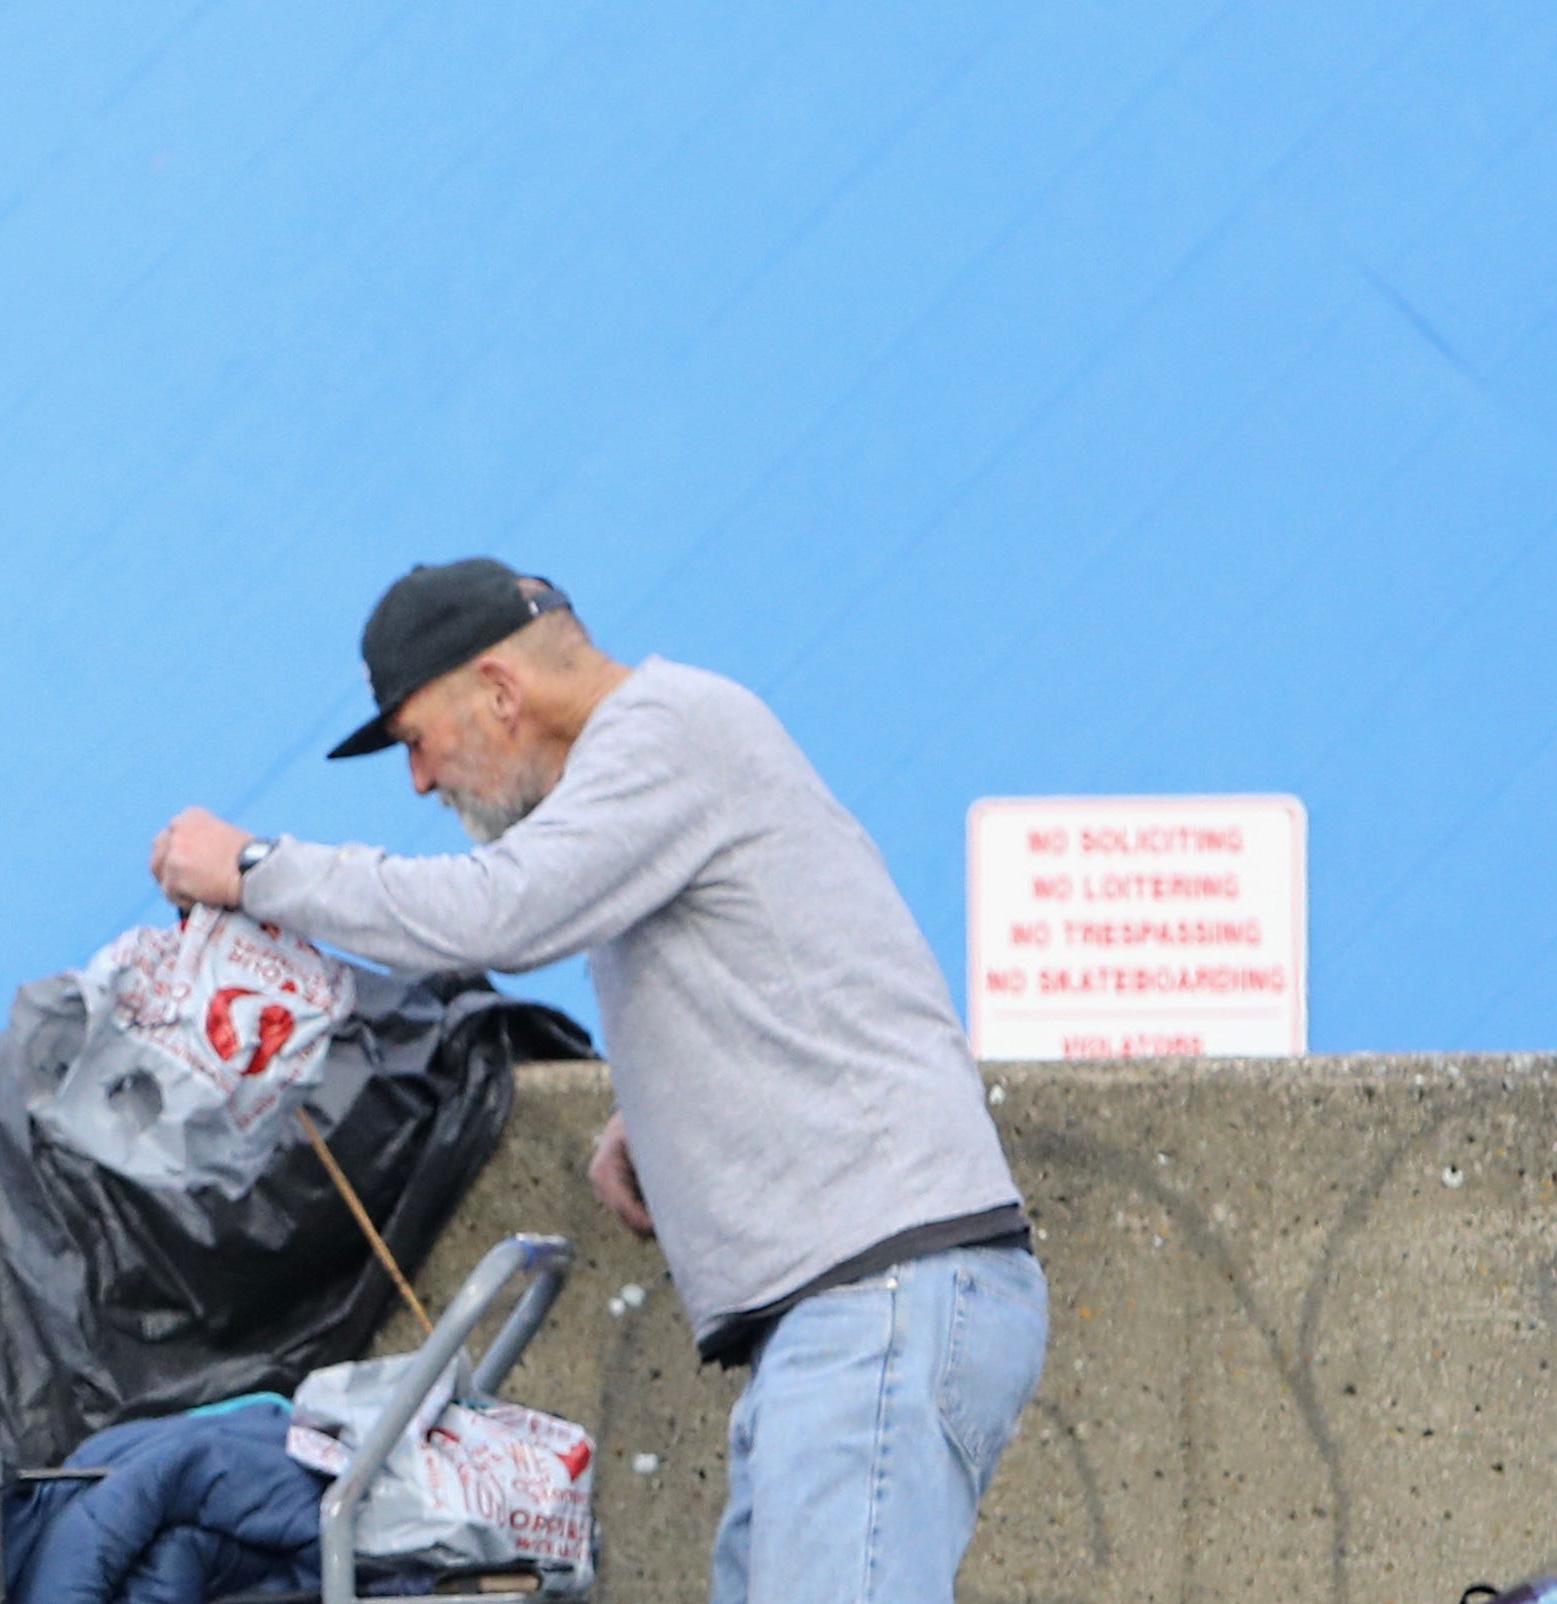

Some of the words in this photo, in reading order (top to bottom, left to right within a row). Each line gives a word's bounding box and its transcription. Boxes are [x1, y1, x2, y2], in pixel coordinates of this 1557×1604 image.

[1028, 827, 1069, 855] NO
[1080, 826, 1244, 855] SOLICITING
[1032, 875, 1073, 902] NO
[1084, 874, 1240, 902] LOITERING
[1010, 921, 1050, 949] NO
[1064, 918, 1262, 948] TRESPASSING
[986, 968, 1026, 994] NO
[1039, 966, 1285, 994] SKATEBOARDING
